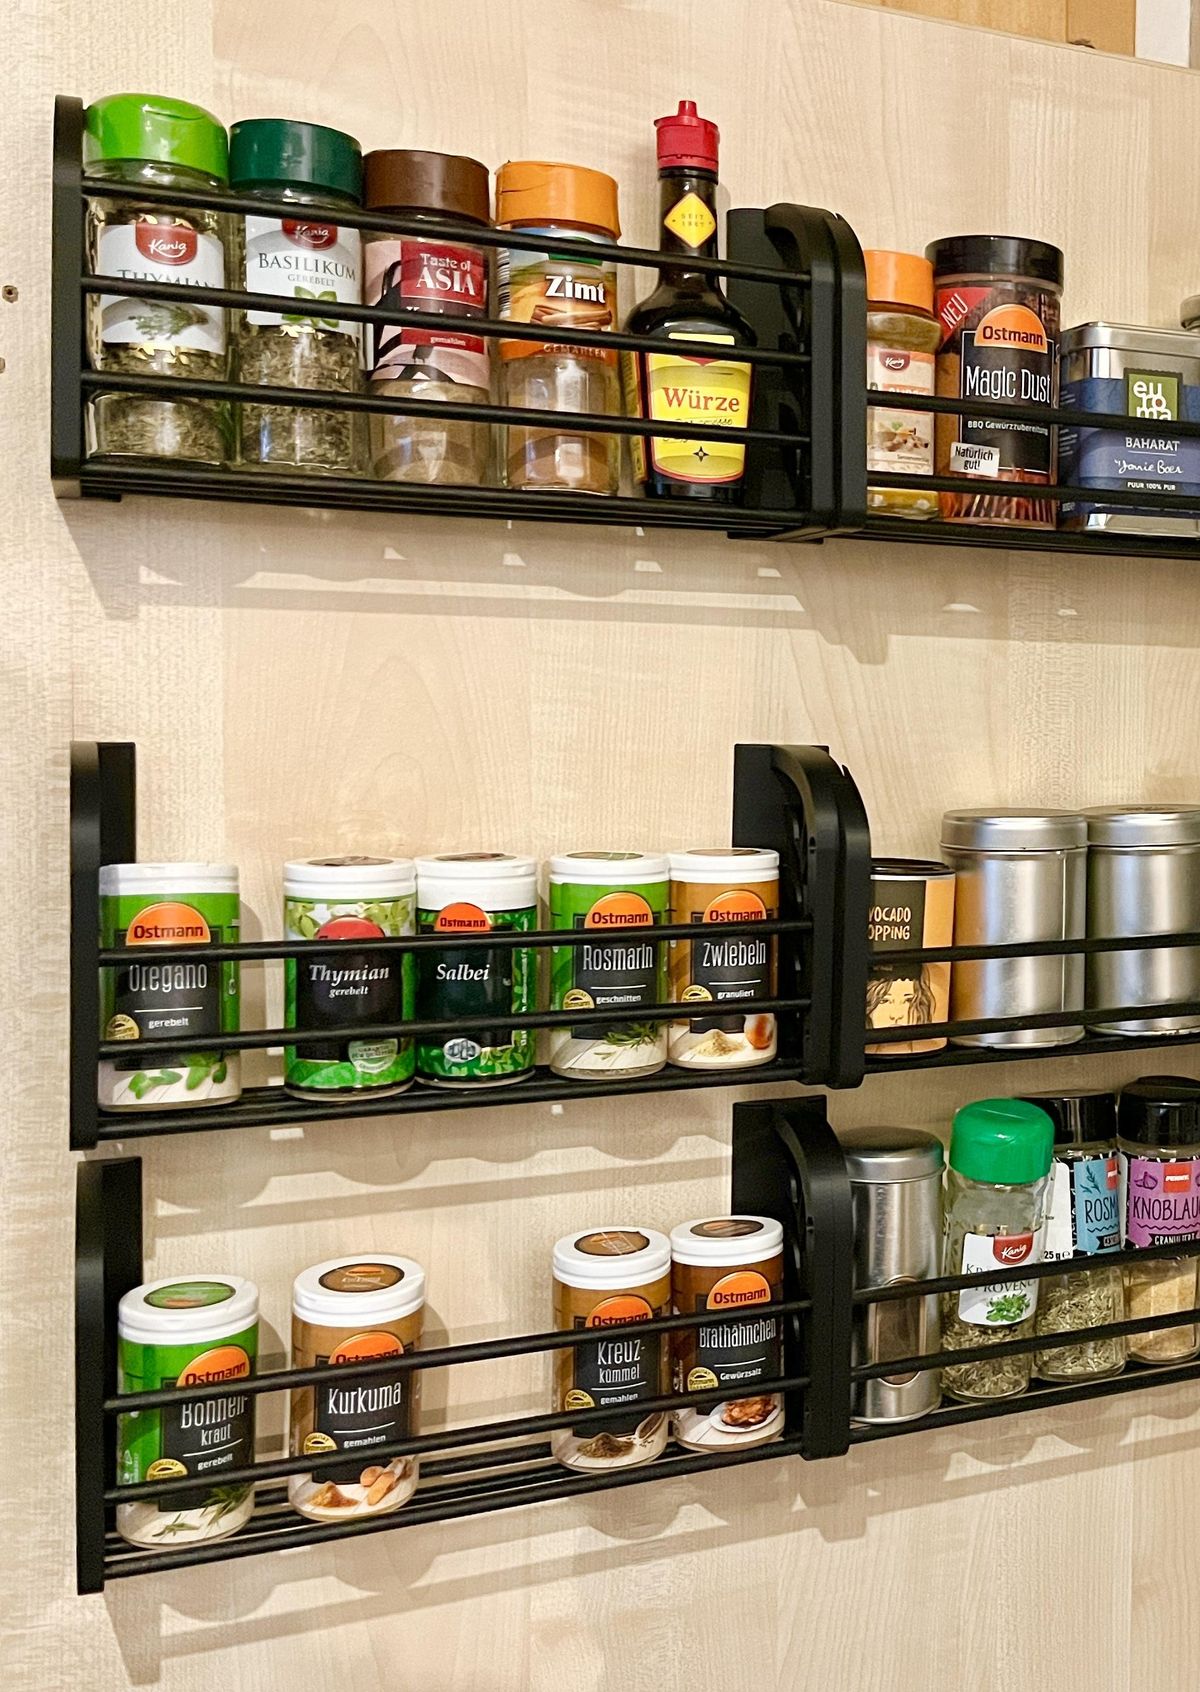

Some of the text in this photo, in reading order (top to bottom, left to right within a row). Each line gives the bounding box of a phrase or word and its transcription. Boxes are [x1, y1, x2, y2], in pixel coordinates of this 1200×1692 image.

[259, 252, 357, 281] BASILIKUM
[419, 253, 471, 272] Taste of
[288, 274, 336, 287] GEREBELT
[416, 266, 476, 296] ASIA
[545, 275, 607, 303] Zimt
[940, 292, 969, 330] NEU
[981, 325, 1044, 347] Ostmann
[543, 343, 607, 359] GEMAHLEN
[966, 365, 1051, 404] Magic Dust
[662, 386, 740, 413] Würze
[968, 421, 983, 429] BBQ
[955, 446, 994, 461] Natürlich
[1125, 437, 1180, 452] BAHARAT
[963, 459, 981, 471] gut!
[1127, 481, 1176, 491] PUUR 100% PUR
[440, 917, 486, 928] Ostmann
[592, 911, 648, 925] Ostmann
[709, 909, 763, 922] Ostmann
[868, 906, 912, 923] VOCADO
[134, 925, 203, 939] Ostmann
[868, 924, 911, 942] OPPING
[582, 943, 653, 971] Rosmarin
[703, 939, 766, 967] Zwiebeln
[129, 964, 208, 993] Oregano
[309, 964, 390, 986] Thymian
[436, 963, 490, 981] Salbei
[328, 986, 368, 998] gerebelt
[596, 994, 641, 1004] geschnitten
[717, 989, 755, 1000] granuliert
[148, 1018, 189, 1029] gerebelt
[1085, 1195, 1118, 1223] ROSM
[1044, 1251, 1054, 1260] 25
[713, 1287, 767, 1305] Ostmann
[592, 1312, 649, 1327] Ostmann
[699, 1318, 777, 1348] Brathähnchen
[597, 1339, 645, 1365] Kreuz-
[185, 1362, 246, 1385] Ostmann
[599, 1364, 640, 1384] kümmel
[720, 1367, 762, 1382] Gewürzsalz
[328, 1382, 402, 1414] Kurkuma
[600, 1392, 638, 1406] gemahlen
[201, 1424, 232, 1446] kraut
[343, 1435, 386, 1449] gemahlen
[197, 1453, 233, 1471] gerebelt
